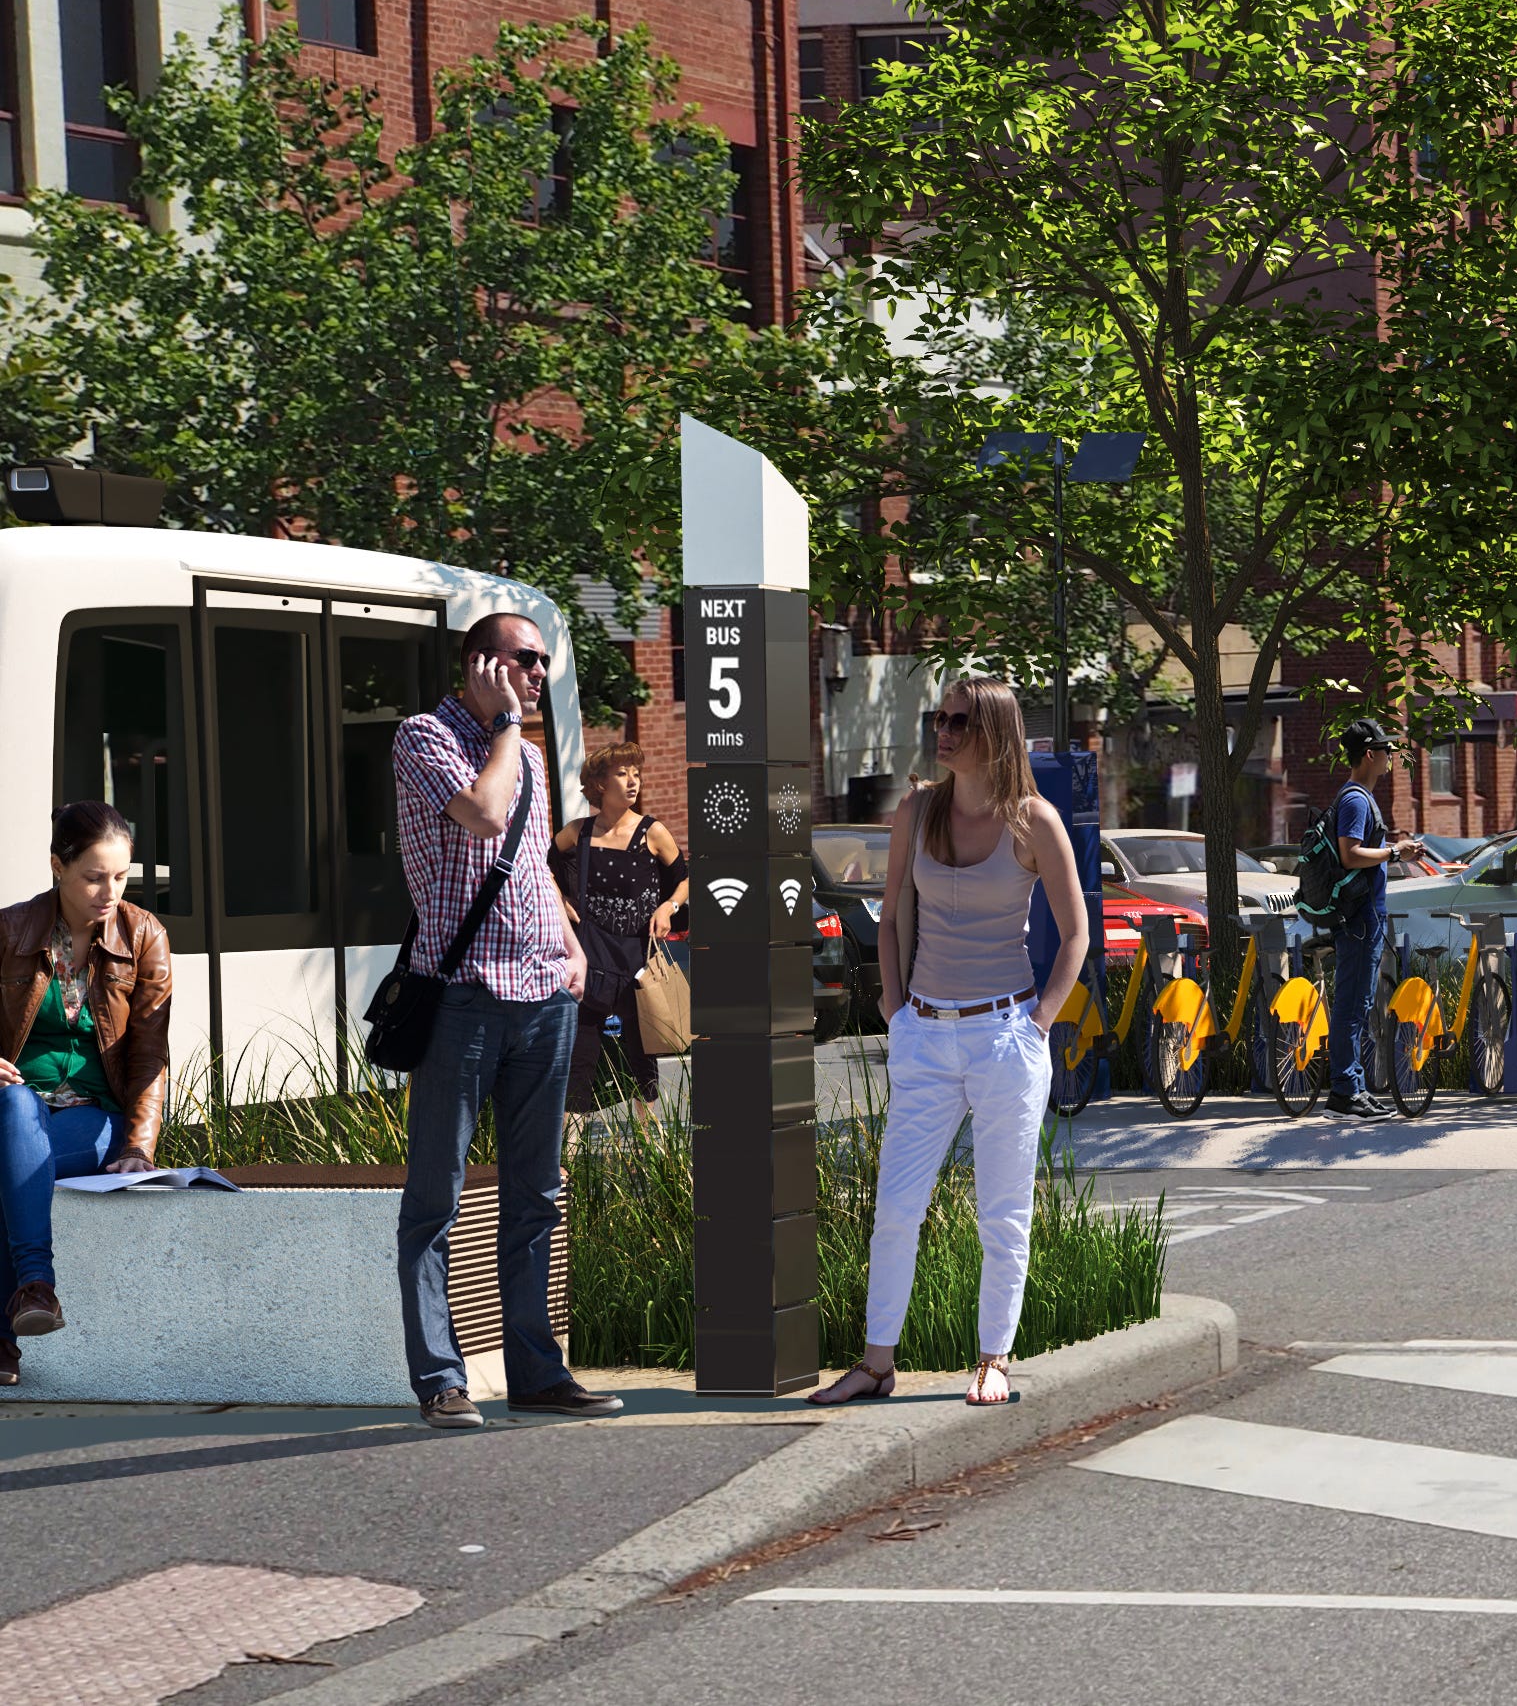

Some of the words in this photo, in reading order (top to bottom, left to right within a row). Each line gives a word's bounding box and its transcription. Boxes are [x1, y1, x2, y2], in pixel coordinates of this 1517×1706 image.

[700, 599, 746, 618] NEXT
[706, 626, 741, 645] BUS
[708, 656, 742, 720] 5
[706, 728, 744, 747] mins
